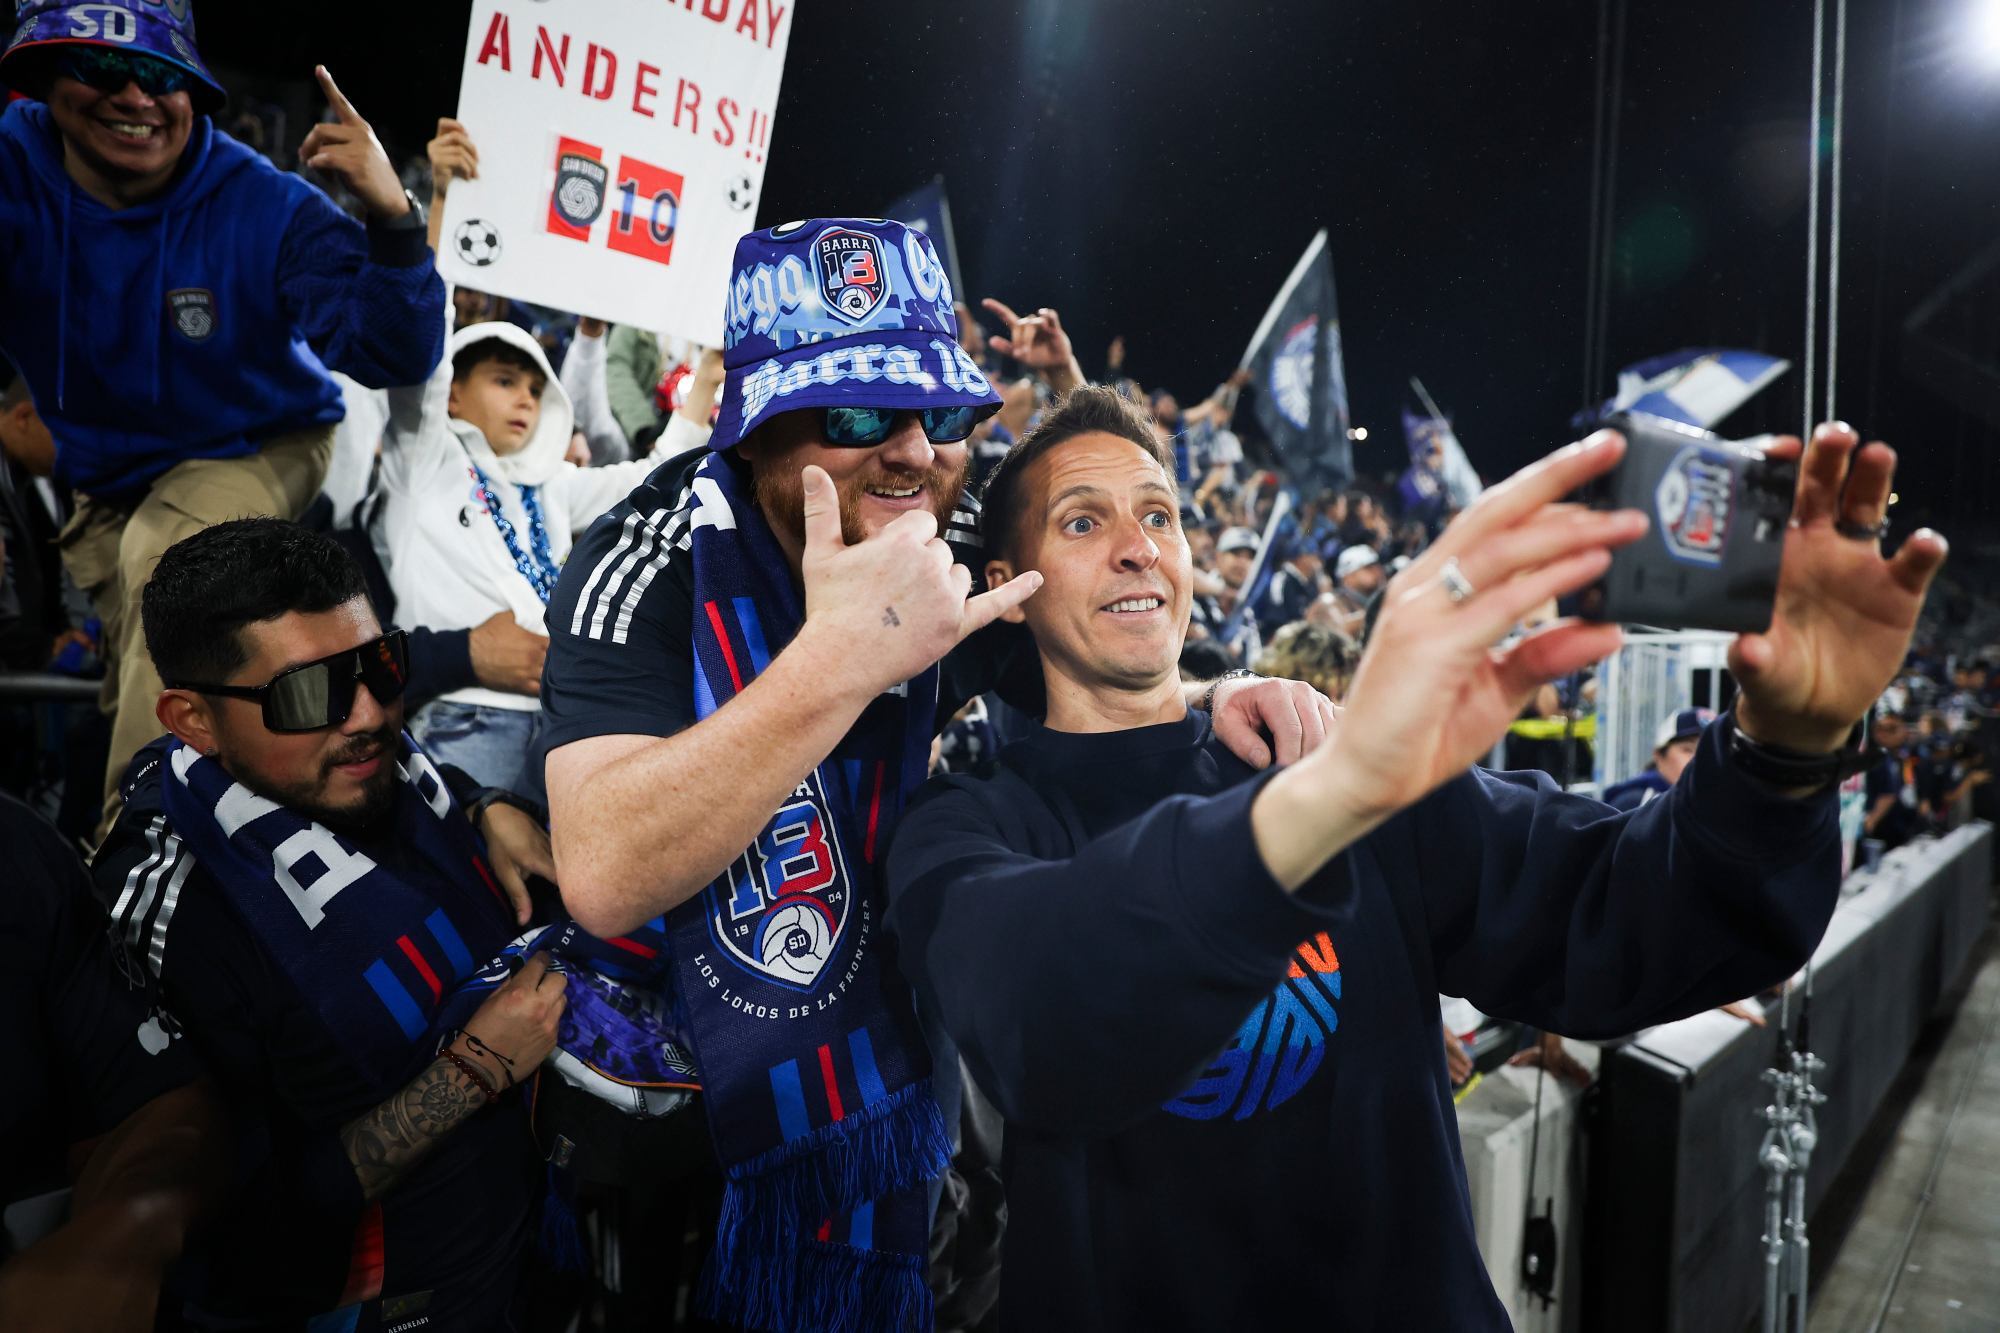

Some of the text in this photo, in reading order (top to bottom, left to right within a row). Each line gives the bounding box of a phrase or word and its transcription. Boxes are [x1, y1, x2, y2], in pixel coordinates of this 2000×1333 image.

[67, 3, 136, 43] SD
[477, 11, 768, 163] ANDERS!!
[617, 179, 679, 245] 10
[822, 237, 871, 253] BARRA
[824, 250, 878, 290] 18
[740, 340, 991, 439] Barra 18
[828, 891, 843, 904] 04
[734, 923, 750, 938] 19
[788, 933, 808, 950] SD
[694, 953, 721, 989] LOS
[720, 988, 779, 1019] LOKOS
[788, 1005, 811, 1019] DE
[817, 991, 838, 1011] LA
[838, 899, 870, 993] FRONTERA
[388, 1316, 430, 1333] AEROREADY
